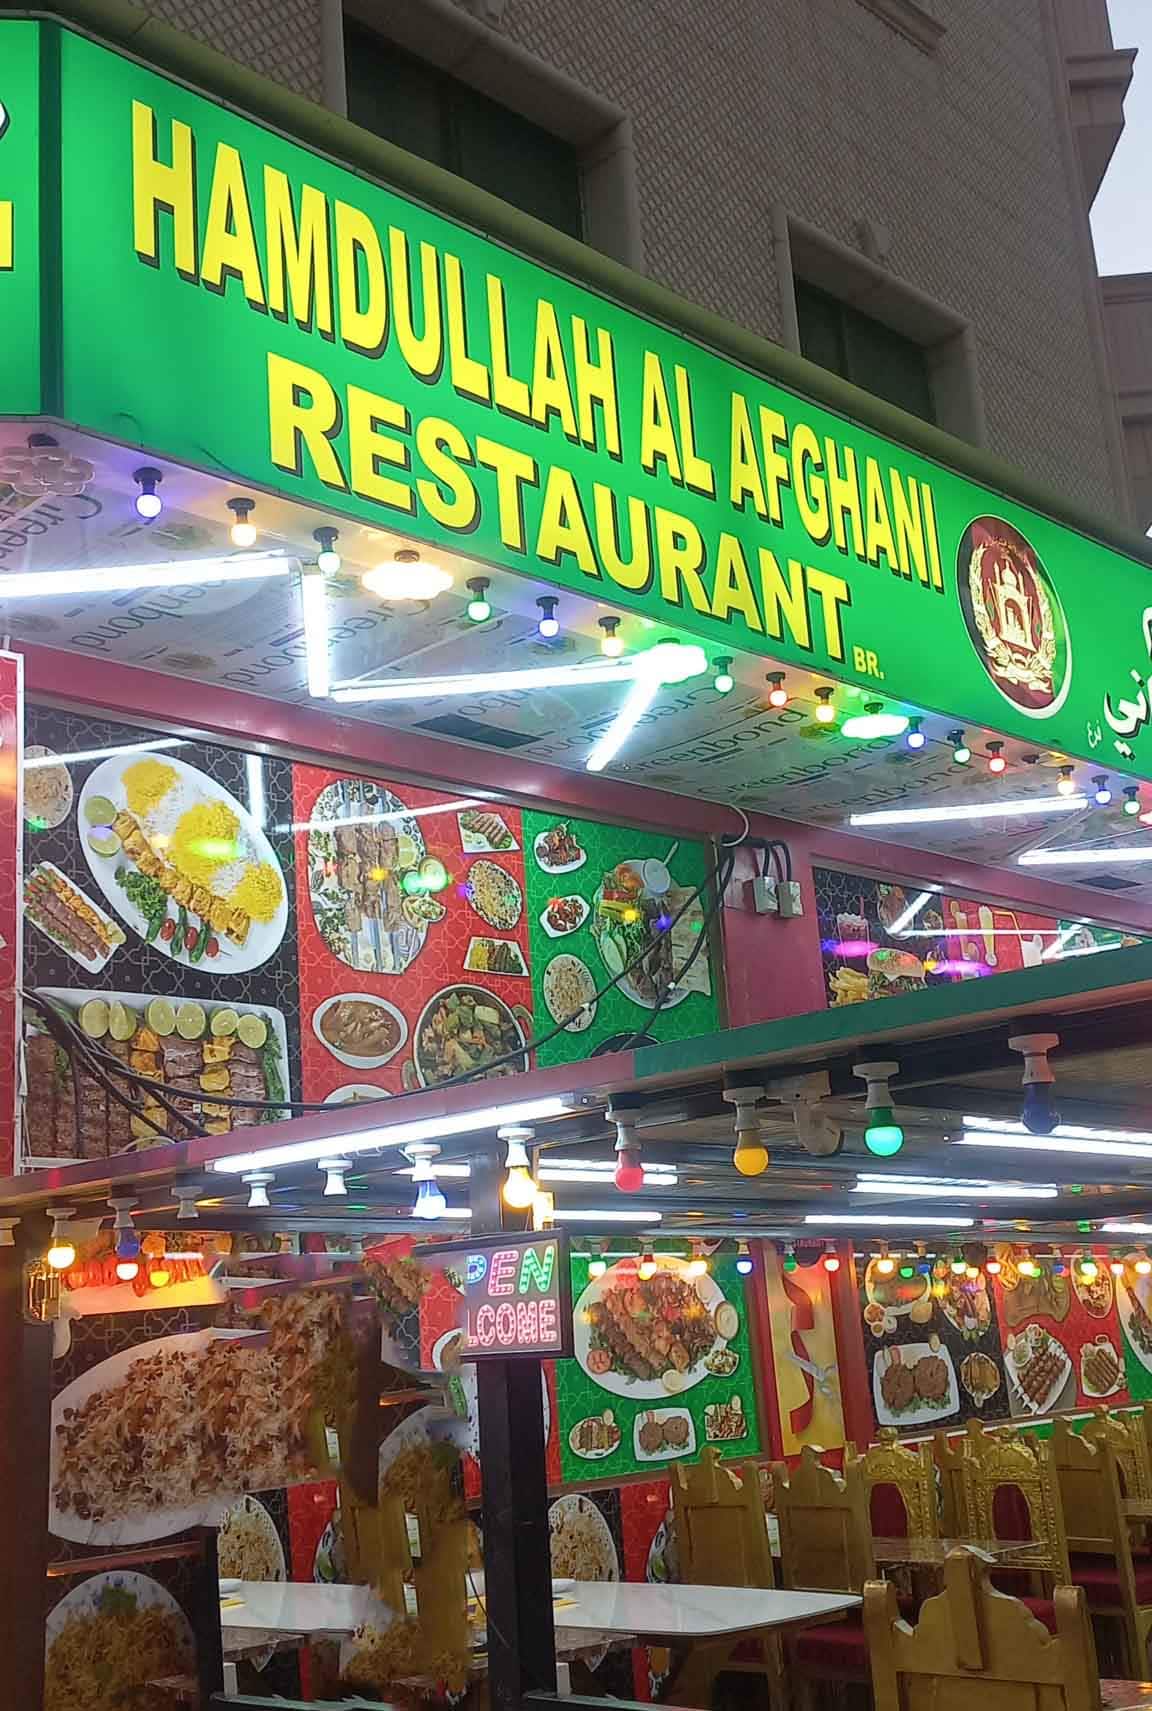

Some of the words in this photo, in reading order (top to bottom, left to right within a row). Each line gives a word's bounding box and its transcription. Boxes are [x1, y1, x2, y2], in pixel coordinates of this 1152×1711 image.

[132, 100, 623, 459] HAMDULLAH
[641, 351, 715, 498] AL
[730, 392, 944, 592] AFGHANI
[267, 351, 850, 661] RESTAURANT
[853, 645, 885, 680] BR.
